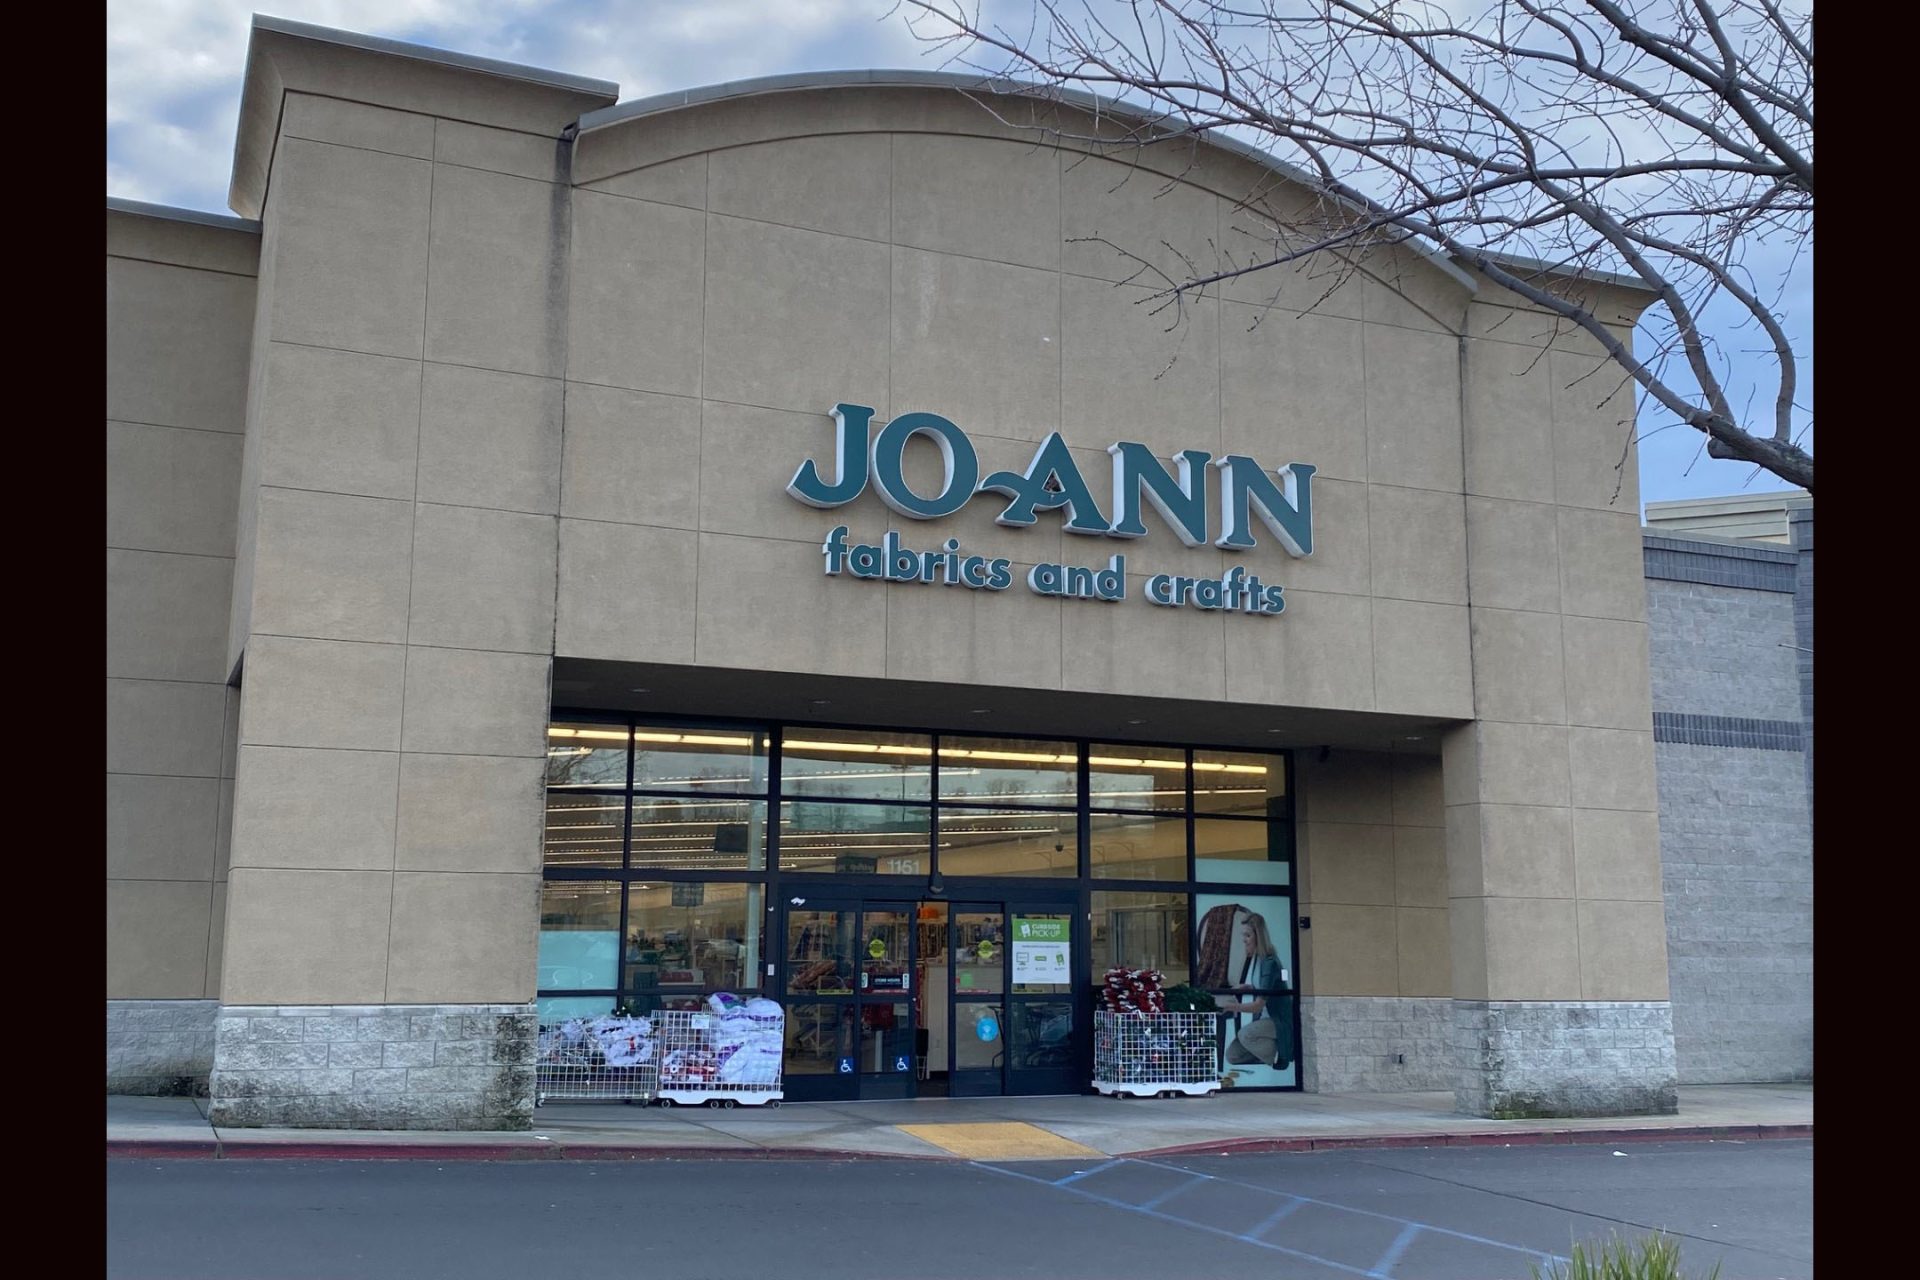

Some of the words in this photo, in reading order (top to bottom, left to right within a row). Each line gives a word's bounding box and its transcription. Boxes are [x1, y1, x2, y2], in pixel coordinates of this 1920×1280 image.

[822, 525, 1012, 590] fabrics
[1027, 555, 1126, 600] and
[1144, 566, 1286, 615] crafts
[887, 859, 919, 875] 1151
